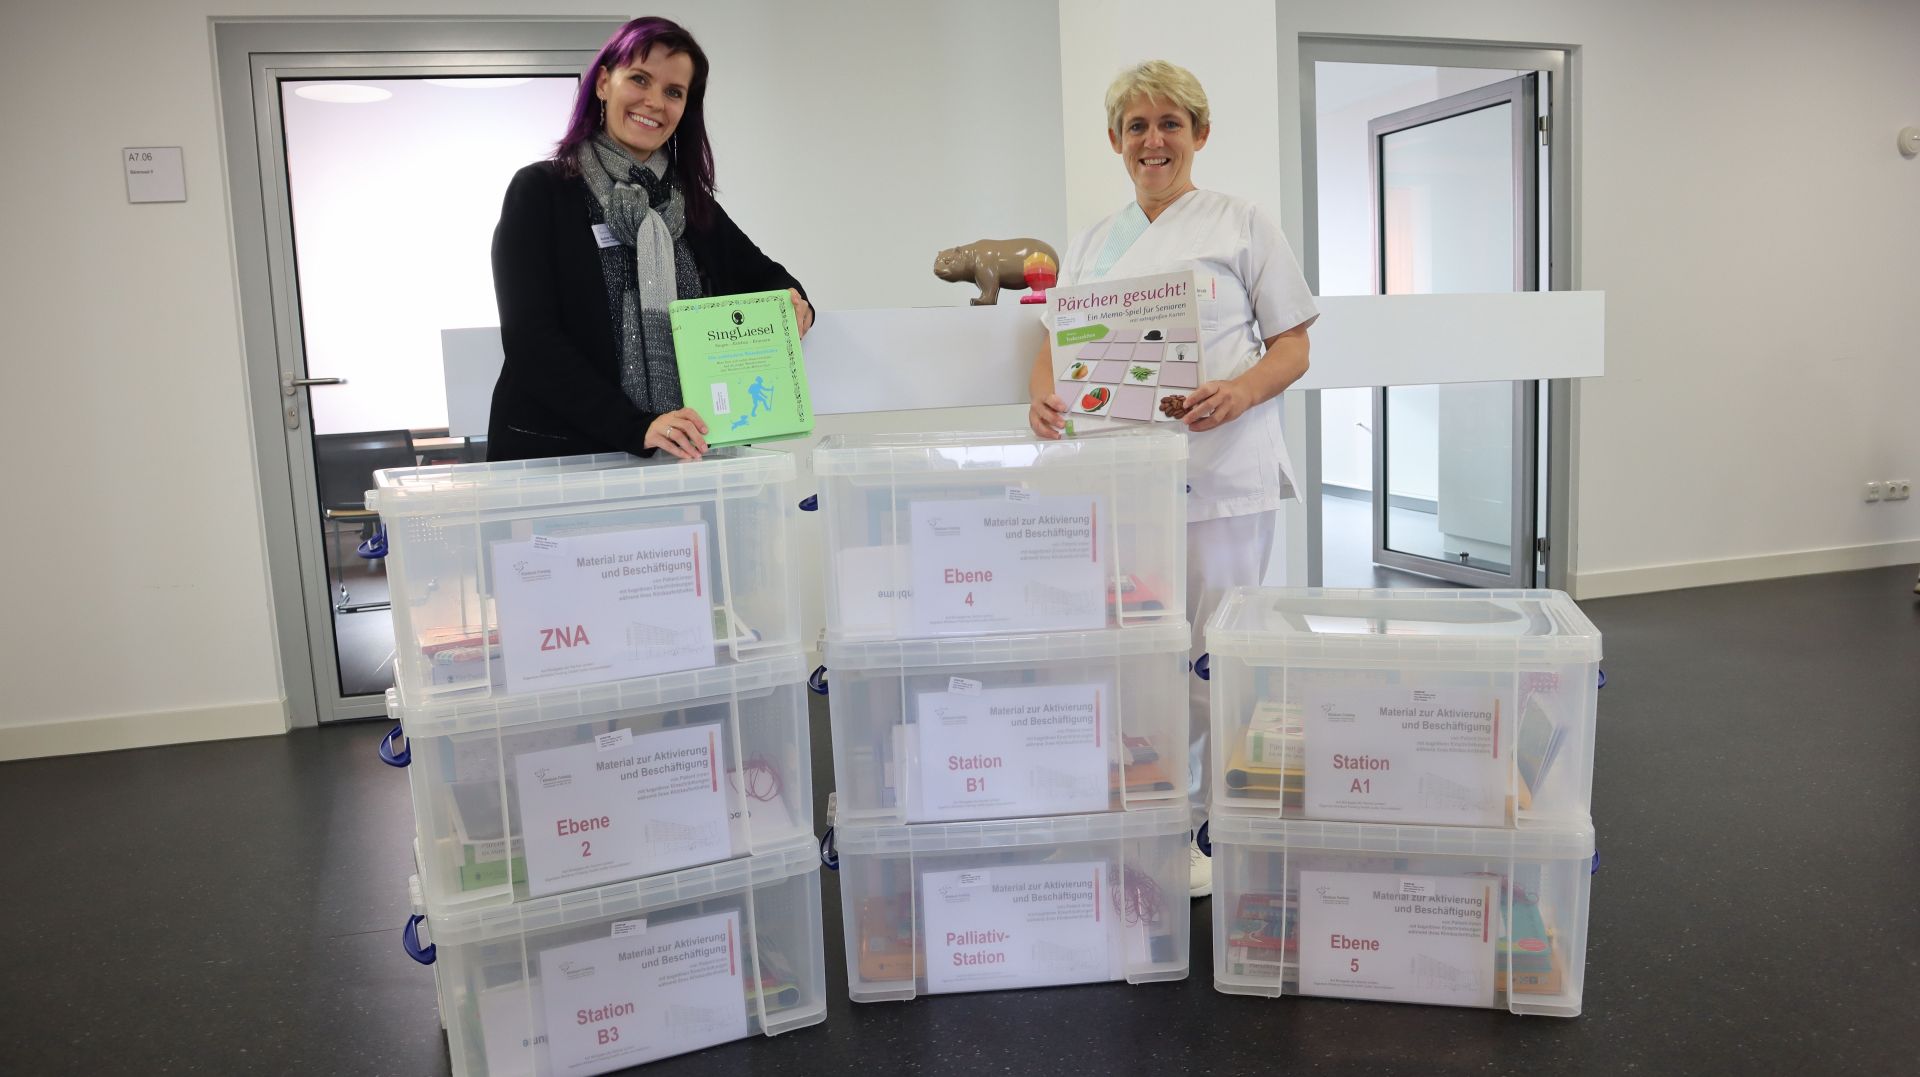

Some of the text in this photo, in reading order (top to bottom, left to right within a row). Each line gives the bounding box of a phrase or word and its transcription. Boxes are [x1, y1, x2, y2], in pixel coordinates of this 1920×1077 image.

[1058, 292, 1118, 312] Pärchen
[1123, 282, 1187, 308] gesucht!
[1087, 314, 1098, 322] Ein
[1100, 306, 1142, 320] Memo-Spiel
[1142, 306, 1154, 316] für
[1156, 302, 1186, 312] Senioren
[707, 324, 774, 341] SingLiesel
[984, 514, 1090, 527] Material zur Aktivierung
[1005, 527, 1090, 540] und Beschäftigung
[576, 546, 692, 568] Material zur Aktivierung
[601, 560, 692, 580] und Beschäftigung
[944, 567, 993, 584] Ebene
[964, 592, 974, 608] 4
[540, 624, 590, 652] ZNA
[990, 702, 1094, 716] Material zur Aktivierung
[1379, 706, 1492, 722] Material zur Aktivierung
[1011, 714, 1094, 727] und Beschäftigung
[1401, 720, 1492, 734] und Beschäftigung
[596, 746, 708, 771] Material zur Aktivierung
[948, 754, 1002, 771] Station
[1332, 754, 1390, 771] Station
[620, 758, 709, 782] und Beschäftigung
[966, 777, 985, 793] B1
[1350, 778, 1371, 794] A1
[556, 814, 610, 838] Ebene
[581, 840, 592, 858] 2
[992, 880, 1093, 893] Material zur Aktivierung
[1012, 891, 1093, 904] und Beschäftigung
[1372, 890, 1409, 902] Material
[1411, 894, 1426, 902] zur
[1394, 904, 1482, 918] und Beschäftigung
[946, 928, 1010, 946] Palliativ-
[1330, 934, 1380, 952] Ebene
[618, 932, 726, 962] Material zur Aktivierung
[641, 944, 728, 970] und Beschäftigung
[952, 950, 1006, 968] Station
[1350, 958, 1360, 974] 5
[576, 1001, 636, 1026] Station
[597, 1026, 620, 1046] B3
